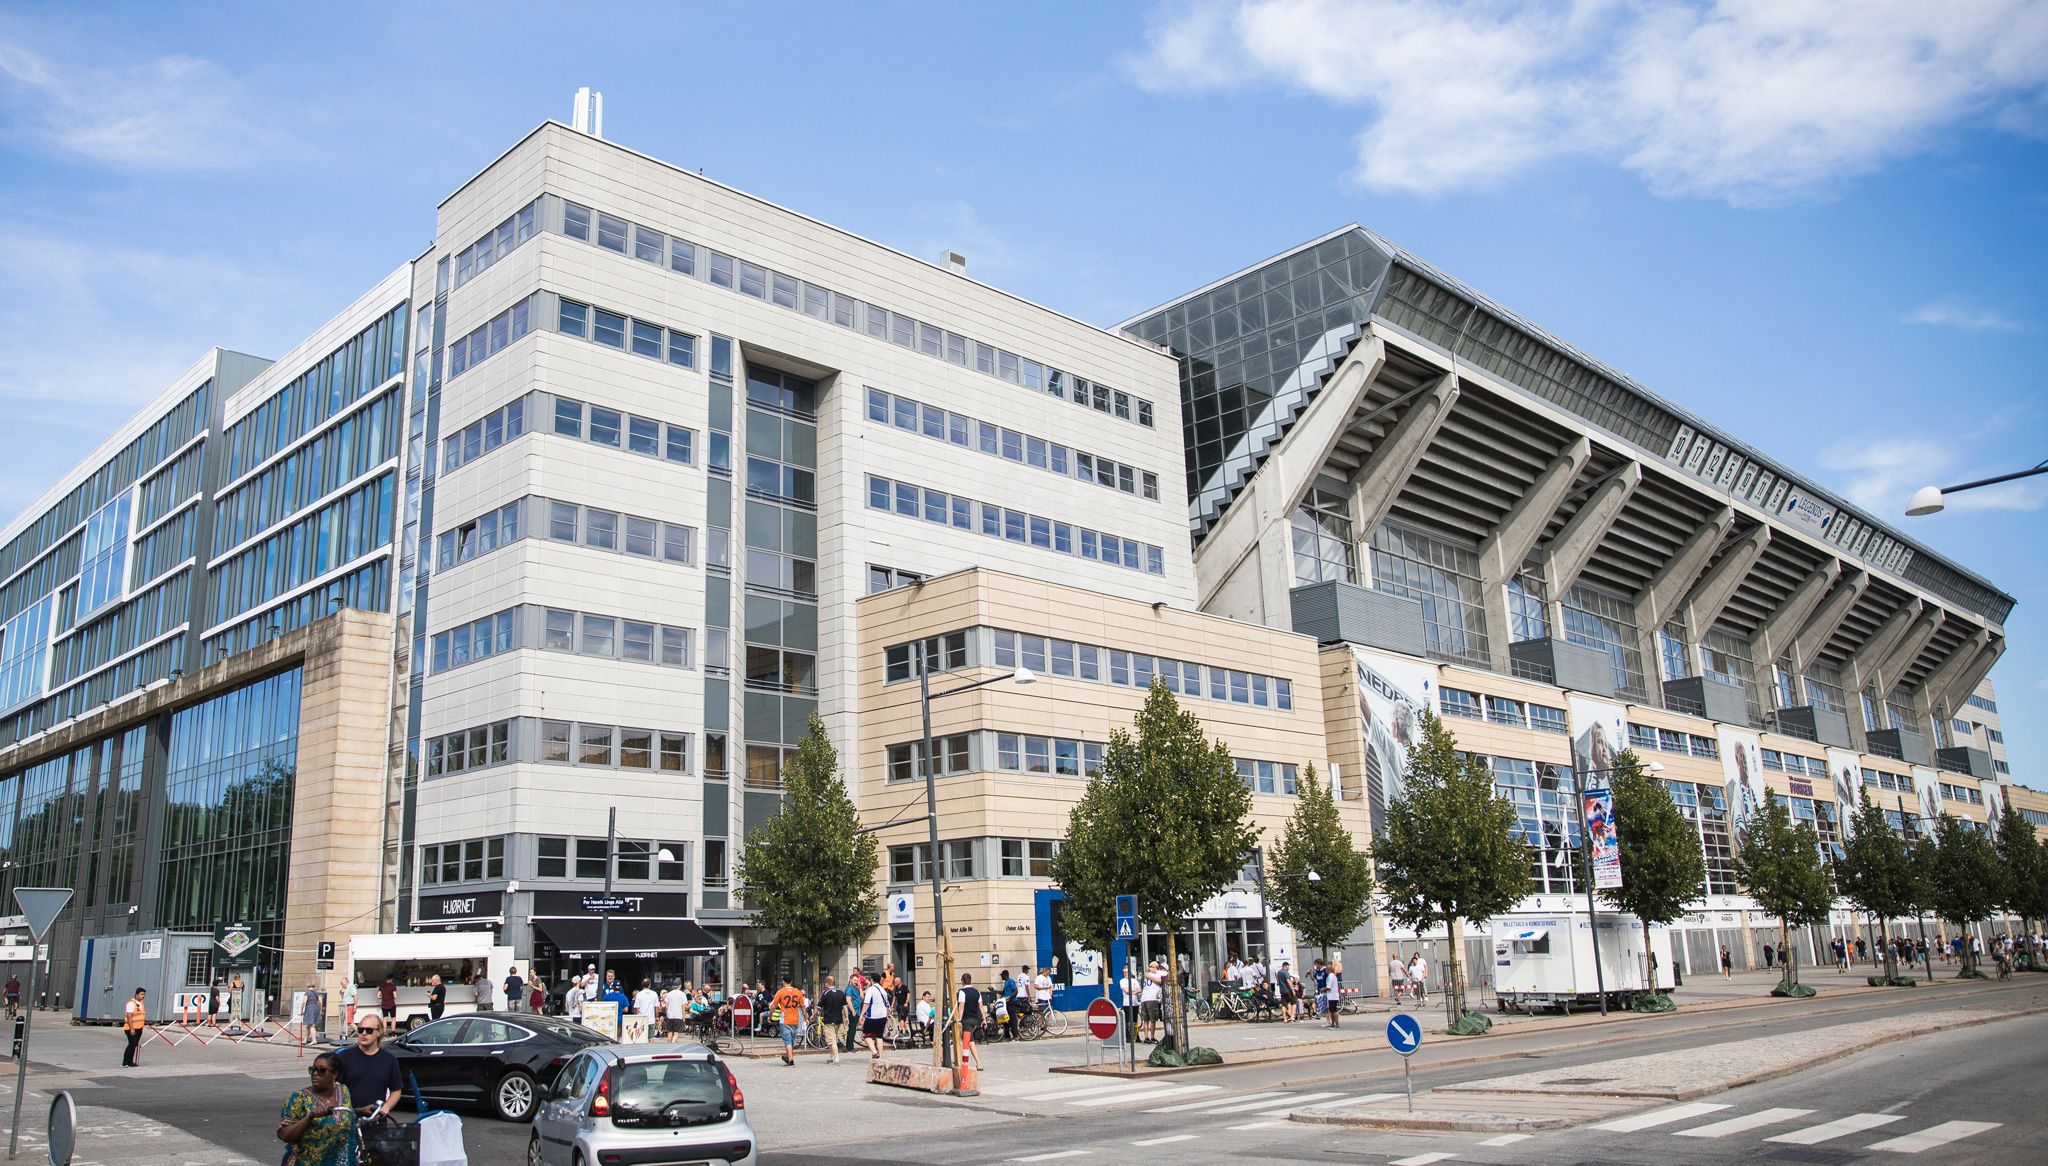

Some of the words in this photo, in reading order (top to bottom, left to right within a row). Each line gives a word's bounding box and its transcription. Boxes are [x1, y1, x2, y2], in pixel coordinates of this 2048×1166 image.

[1674, 436, 1686, 454] 10
[1692, 446, 1704, 464] 17
[1709, 455, 1720, 472] 12
[1726, 463, 1735, 479] 5
[1743, 472, 1752, 488] 10
[1757, 481, 1767, 496] 11
[1798, 498, 1825, 519] LEGENDS
[443, 898, 477, 915] HJØRNET
[323, 943, 330, 957] P
[784, 996, 799, 1009] 25
